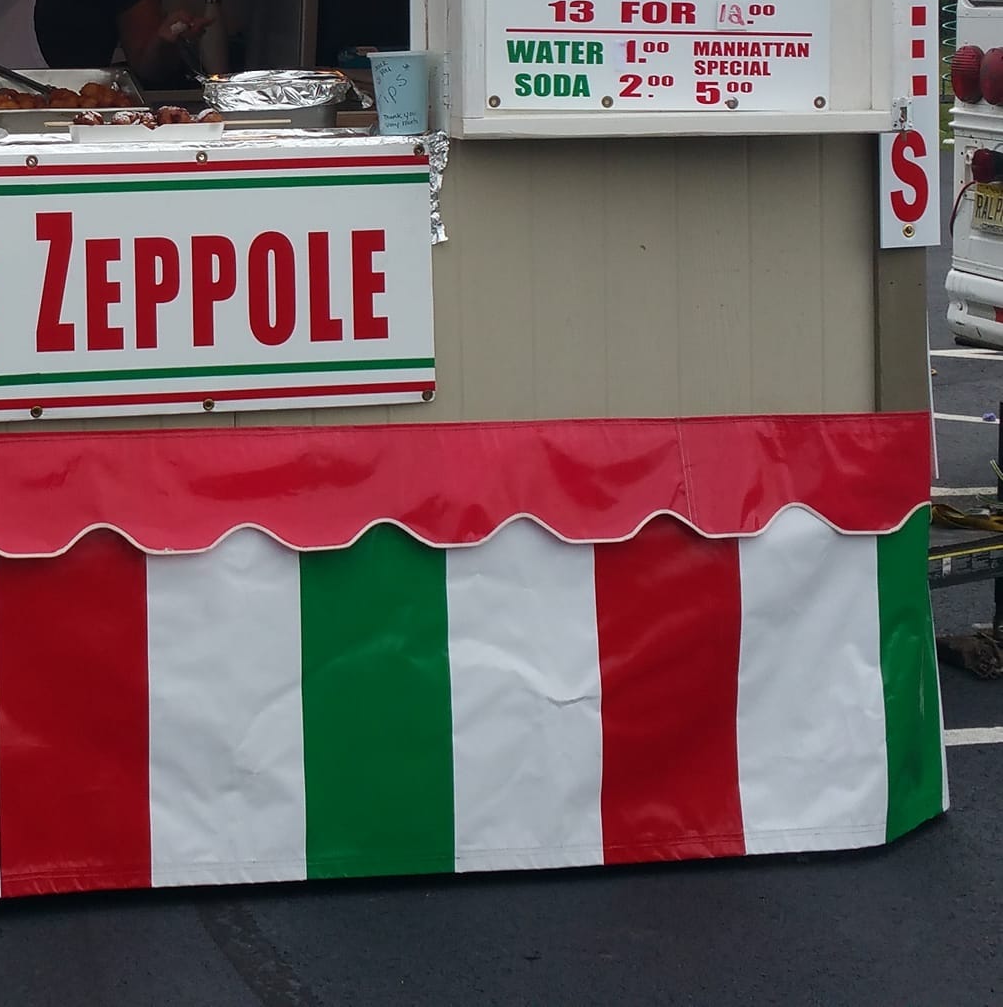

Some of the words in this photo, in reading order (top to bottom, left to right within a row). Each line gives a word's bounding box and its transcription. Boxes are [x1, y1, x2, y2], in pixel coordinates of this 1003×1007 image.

[548, 0, 595, 23] 13
[620, 1, 696, 24] FOR
[506, 39, 604, 65] WATER
[693, 41, 810, 58] MANHATTAN
[694, 60, 772, 76] SPECIAL
[514, 72, 591, 98] SODA
[696, 81, 753, 105] 500
